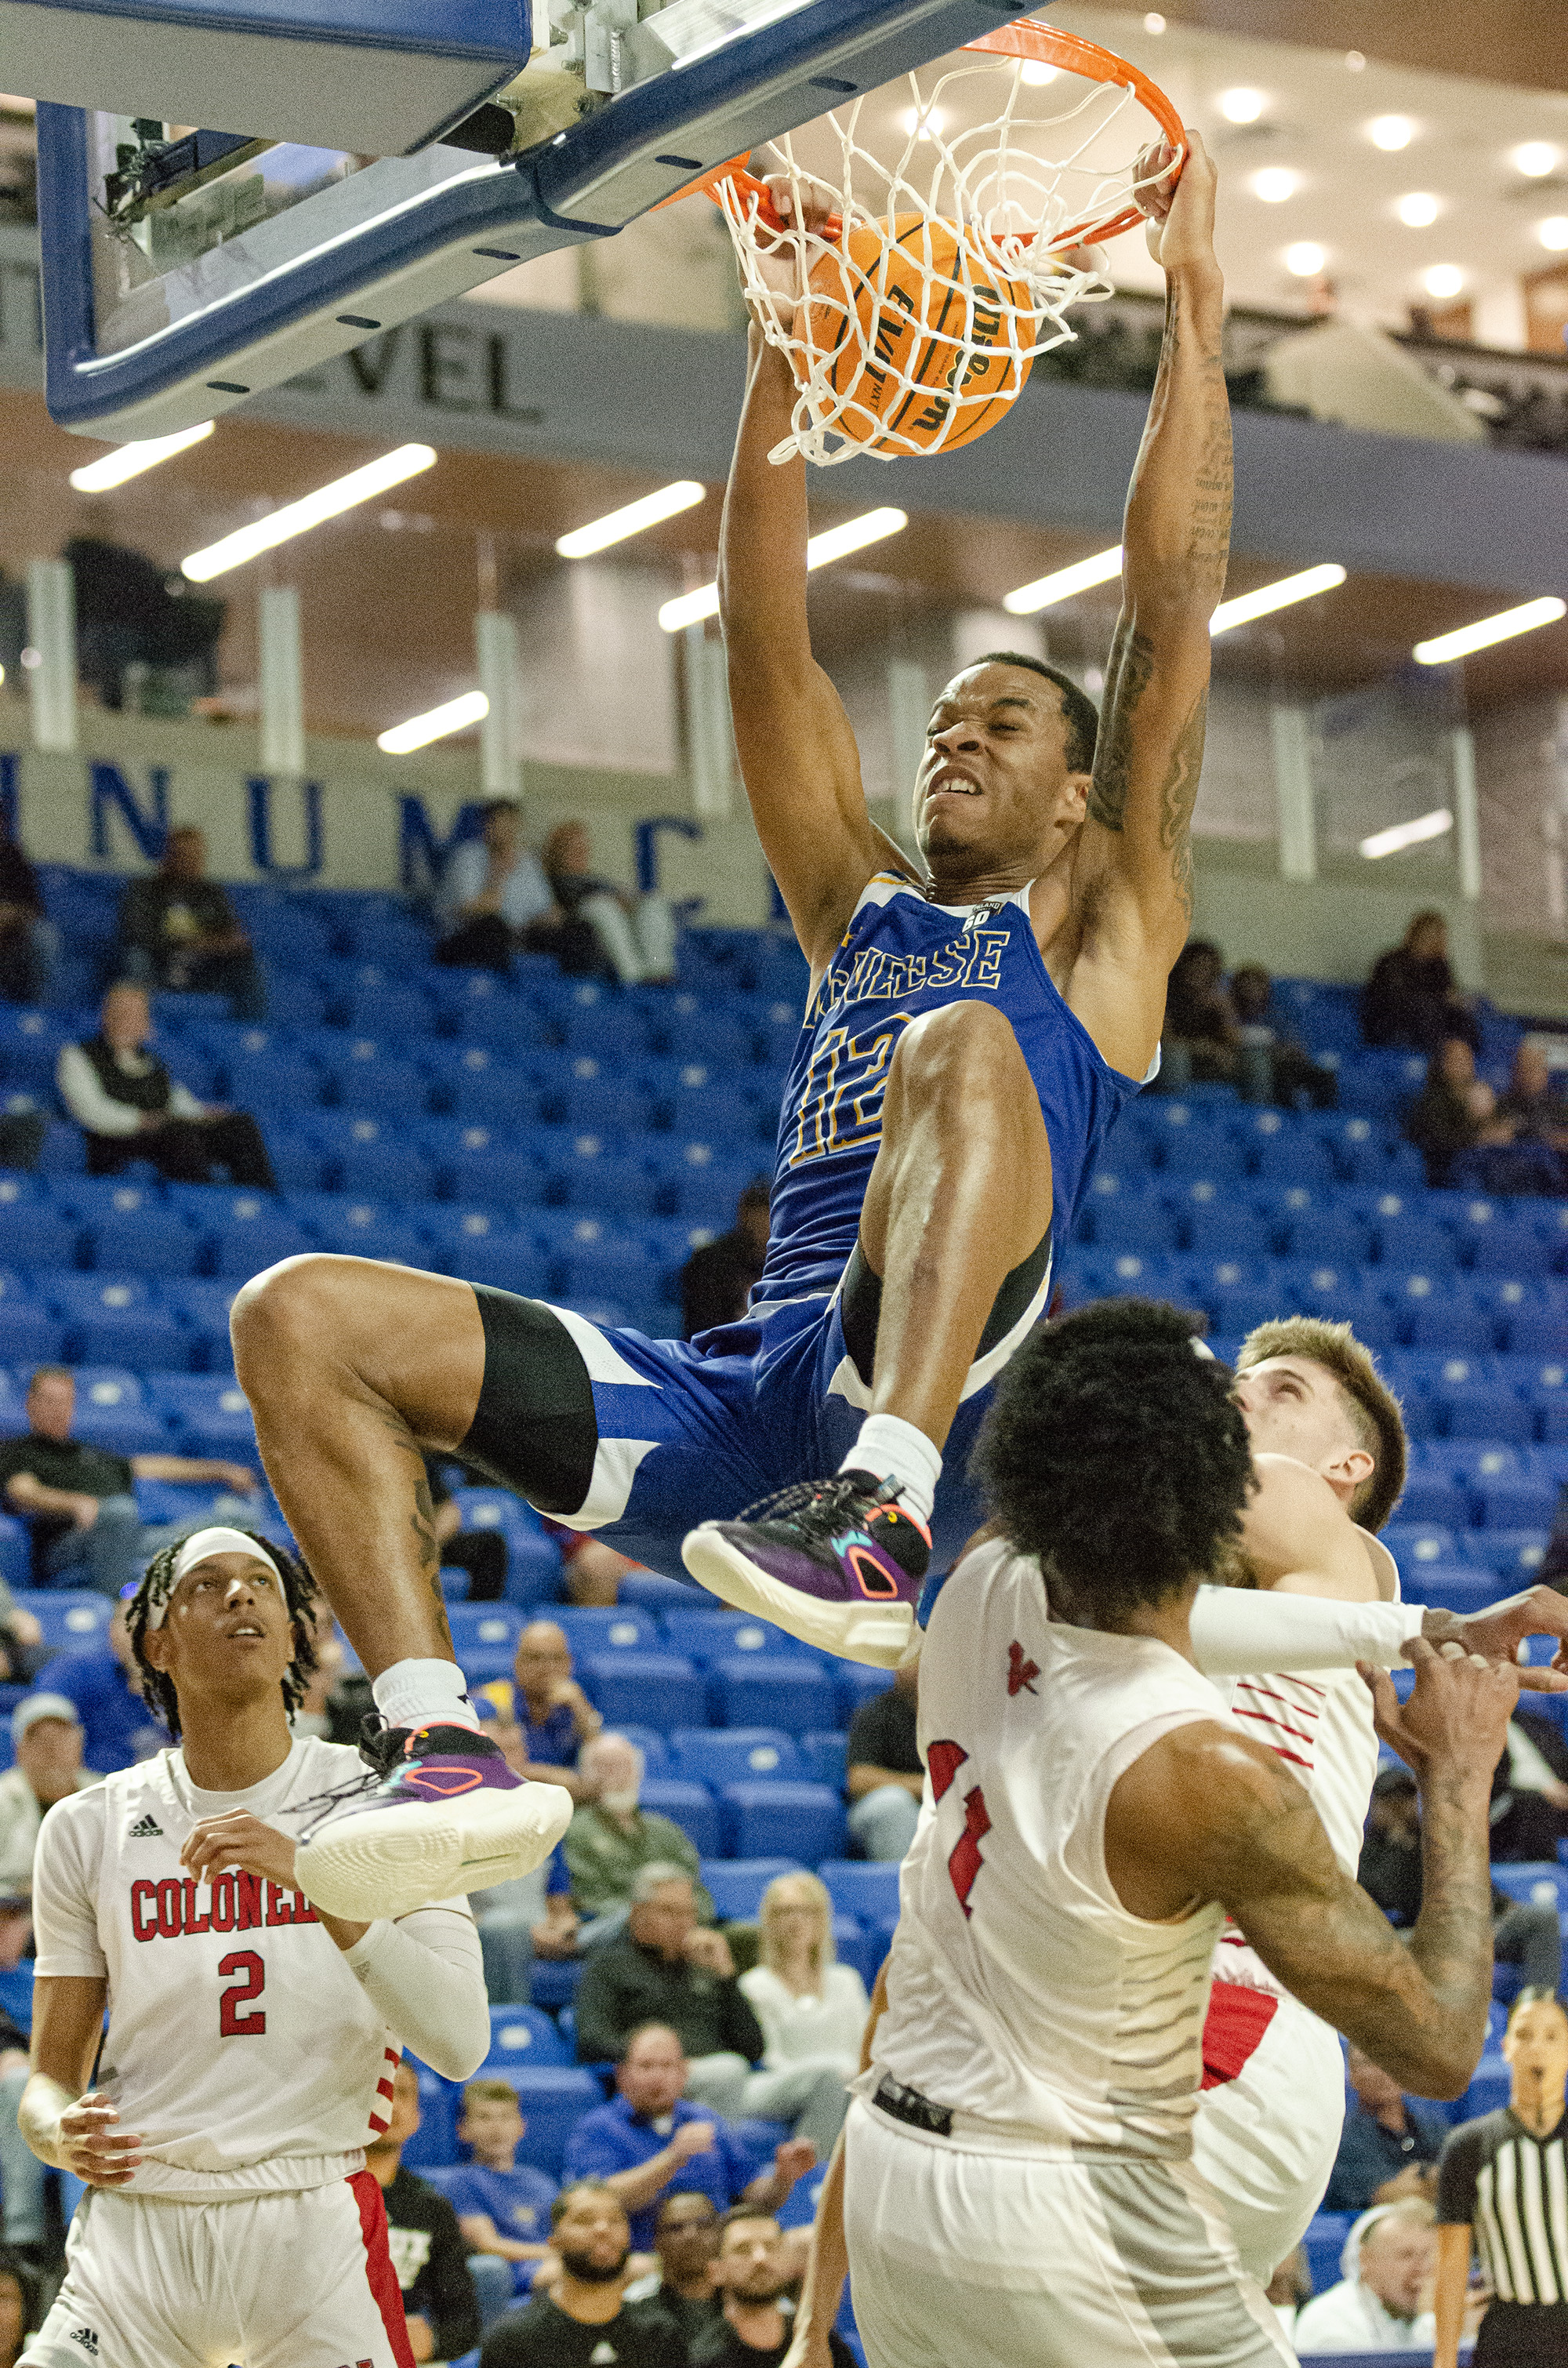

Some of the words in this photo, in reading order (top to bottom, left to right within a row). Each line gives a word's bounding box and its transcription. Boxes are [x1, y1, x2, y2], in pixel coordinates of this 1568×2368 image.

[868, 383, 884, 412] NXT
[962, 910, 990, 933] 60
[789, 1011, 916, 1170] 12
[129, 1829, 164, 1837] adidas
[218, 1949, 267, 2038] 2
[70, 2332, 99, 2356] adidas
